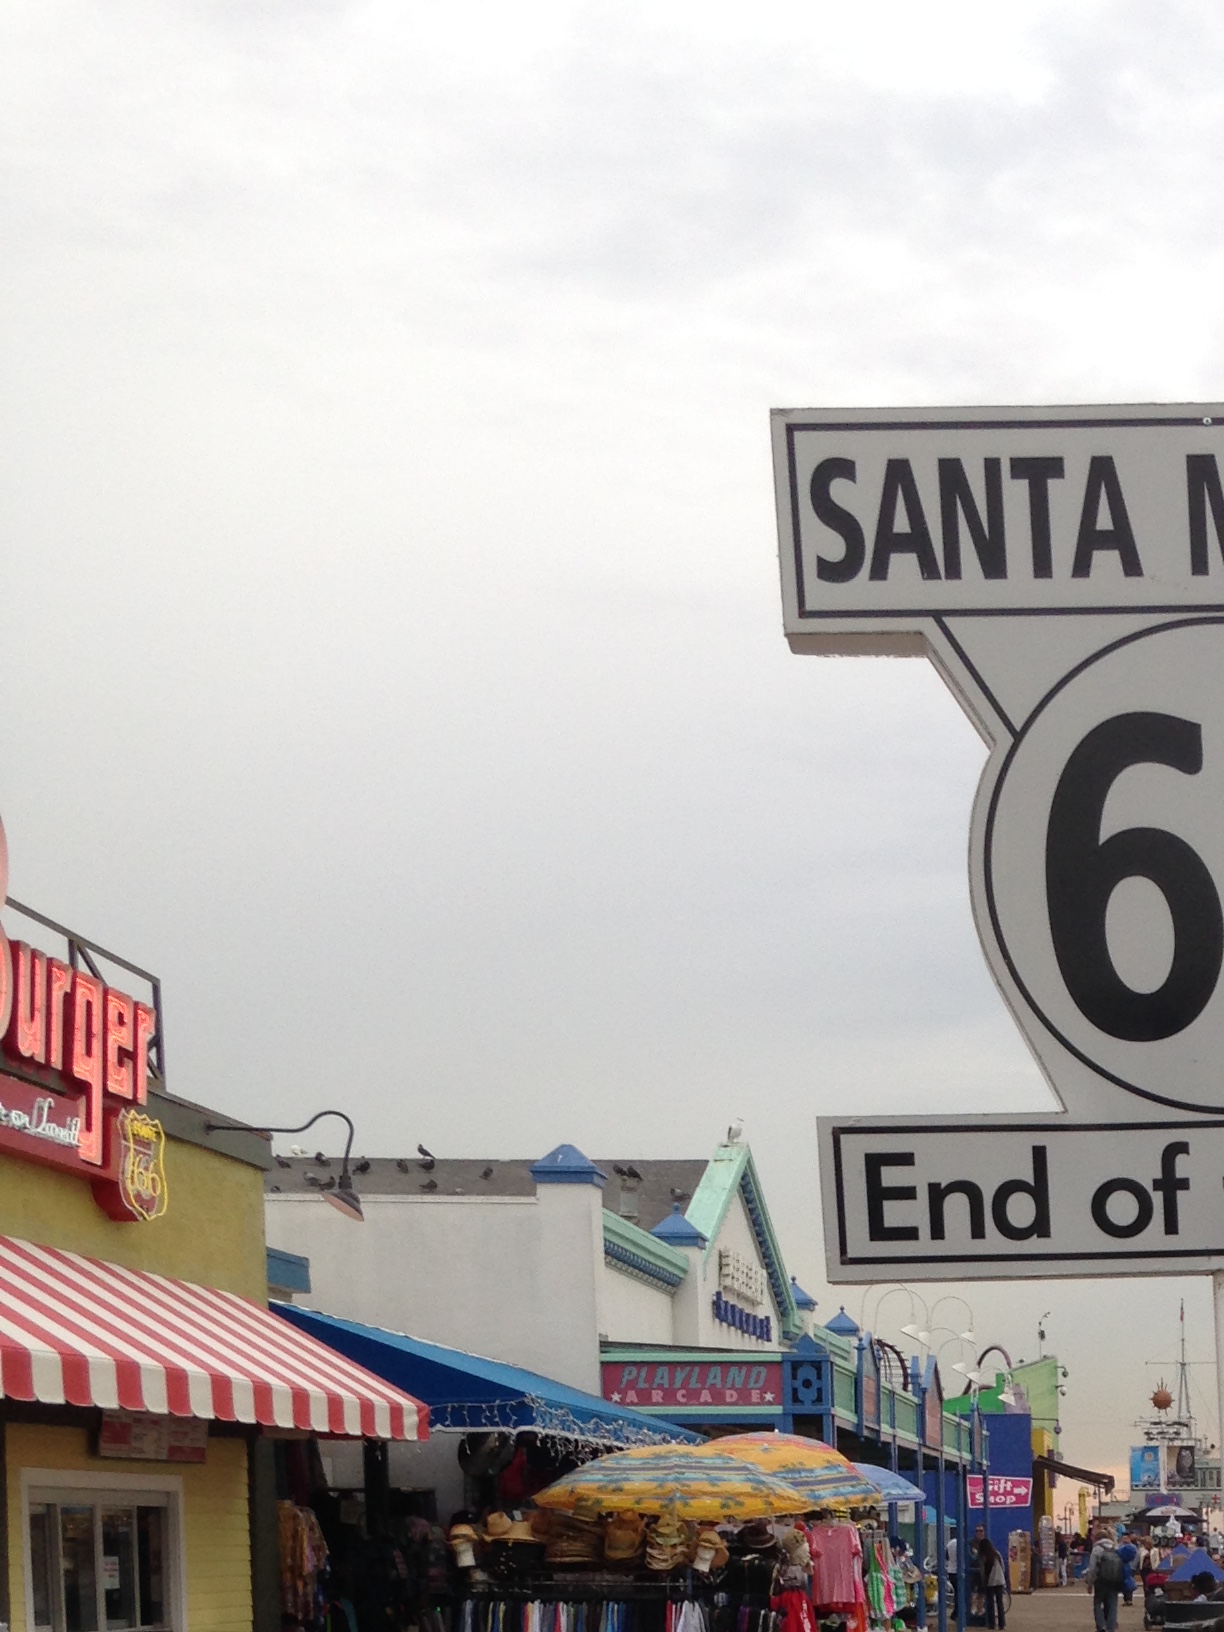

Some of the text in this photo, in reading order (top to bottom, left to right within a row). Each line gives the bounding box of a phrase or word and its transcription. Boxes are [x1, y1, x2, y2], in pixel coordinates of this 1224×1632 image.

[809, 456, 1144, 584] SANTA
[0, 920, 155, 1166] urger
[863, 1144, 1052, 1243] End
[1090, 1140, 1191, 1240] of
[620, 1365, 768, 1389] PLAYLAND
[625, 1389, 762, 1403] ARCADE
